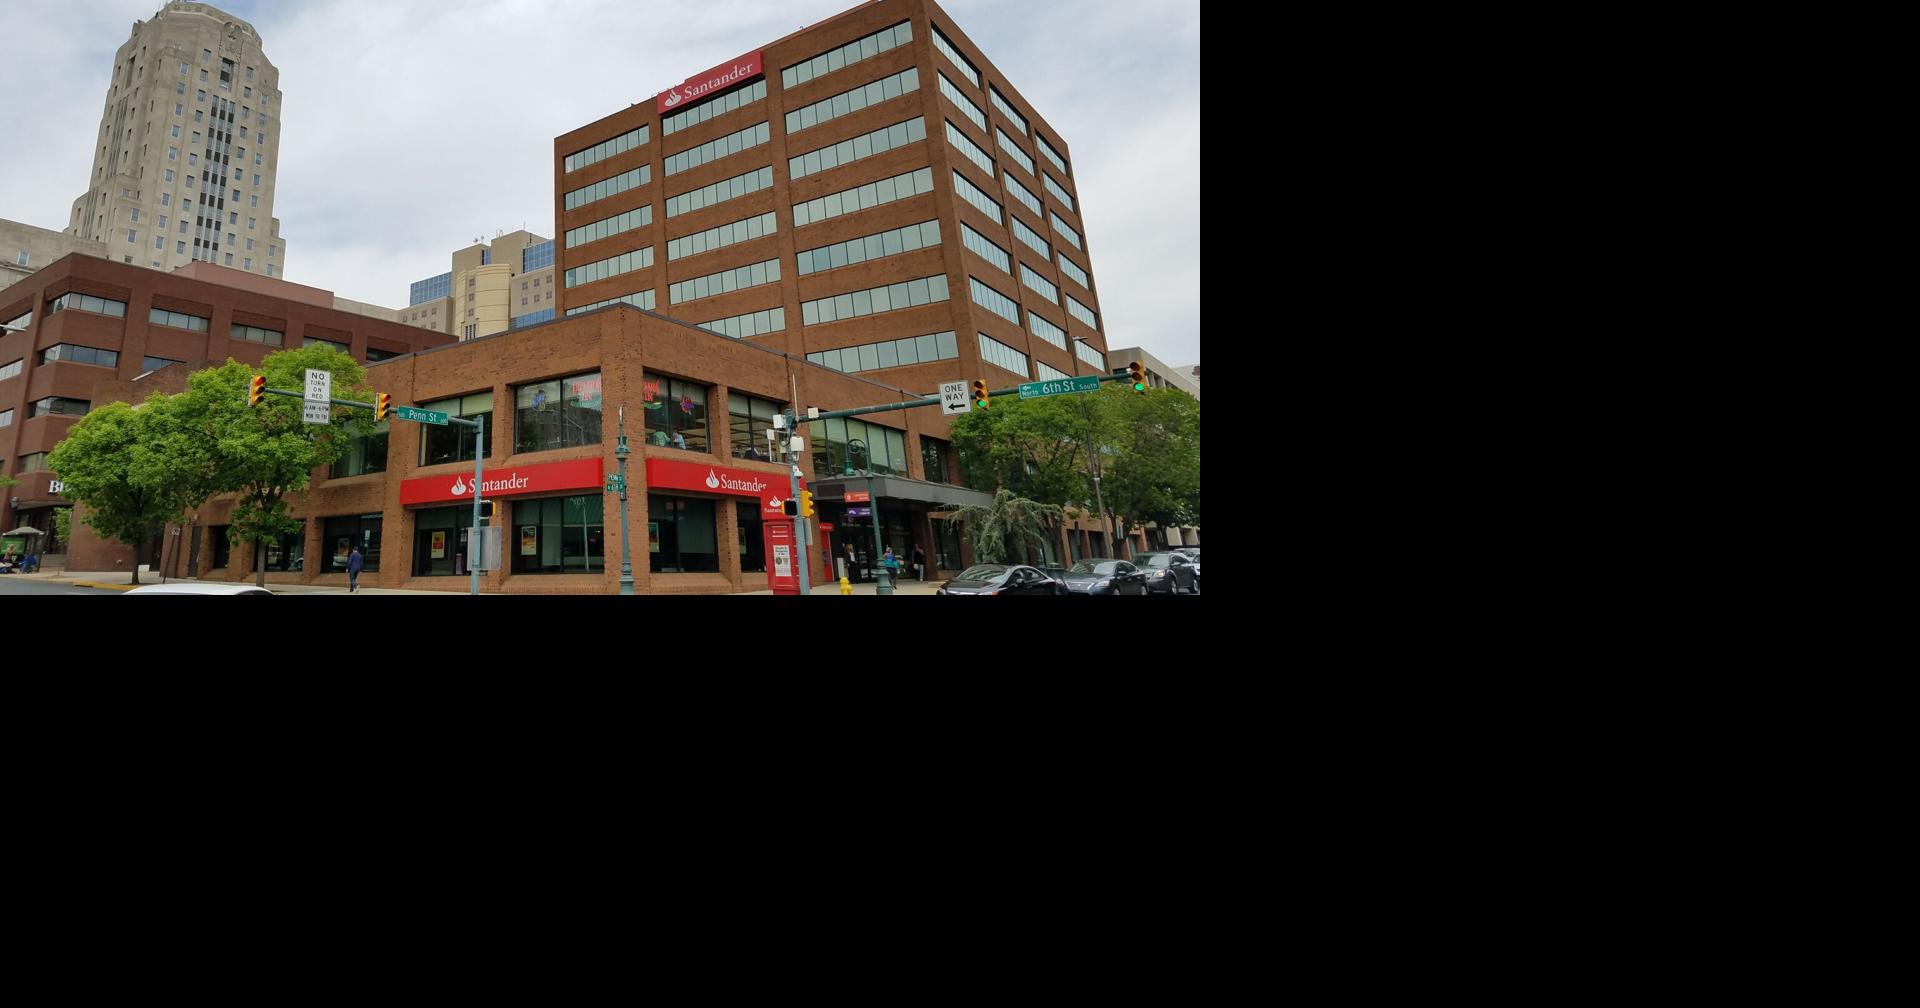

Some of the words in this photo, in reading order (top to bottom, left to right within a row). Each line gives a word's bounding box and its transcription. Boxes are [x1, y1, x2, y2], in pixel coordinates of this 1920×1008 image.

[684, 64, 753, 99] Santander
[311, 372, 325, 380] NO
[944, 383, 962, 393] ONE
[1022, 389, 1039, 397] North
[1042, 382, 1061, 394] 6th
[1063, 380, 1075, 392] St
[1079, 382, 1098, 390] South
[945, 392, 964, 401] WAY
[408, 410, 426, 420] Penn
[429, 412, 437, 422] St
[468, 472, 529, 494] Sntander
